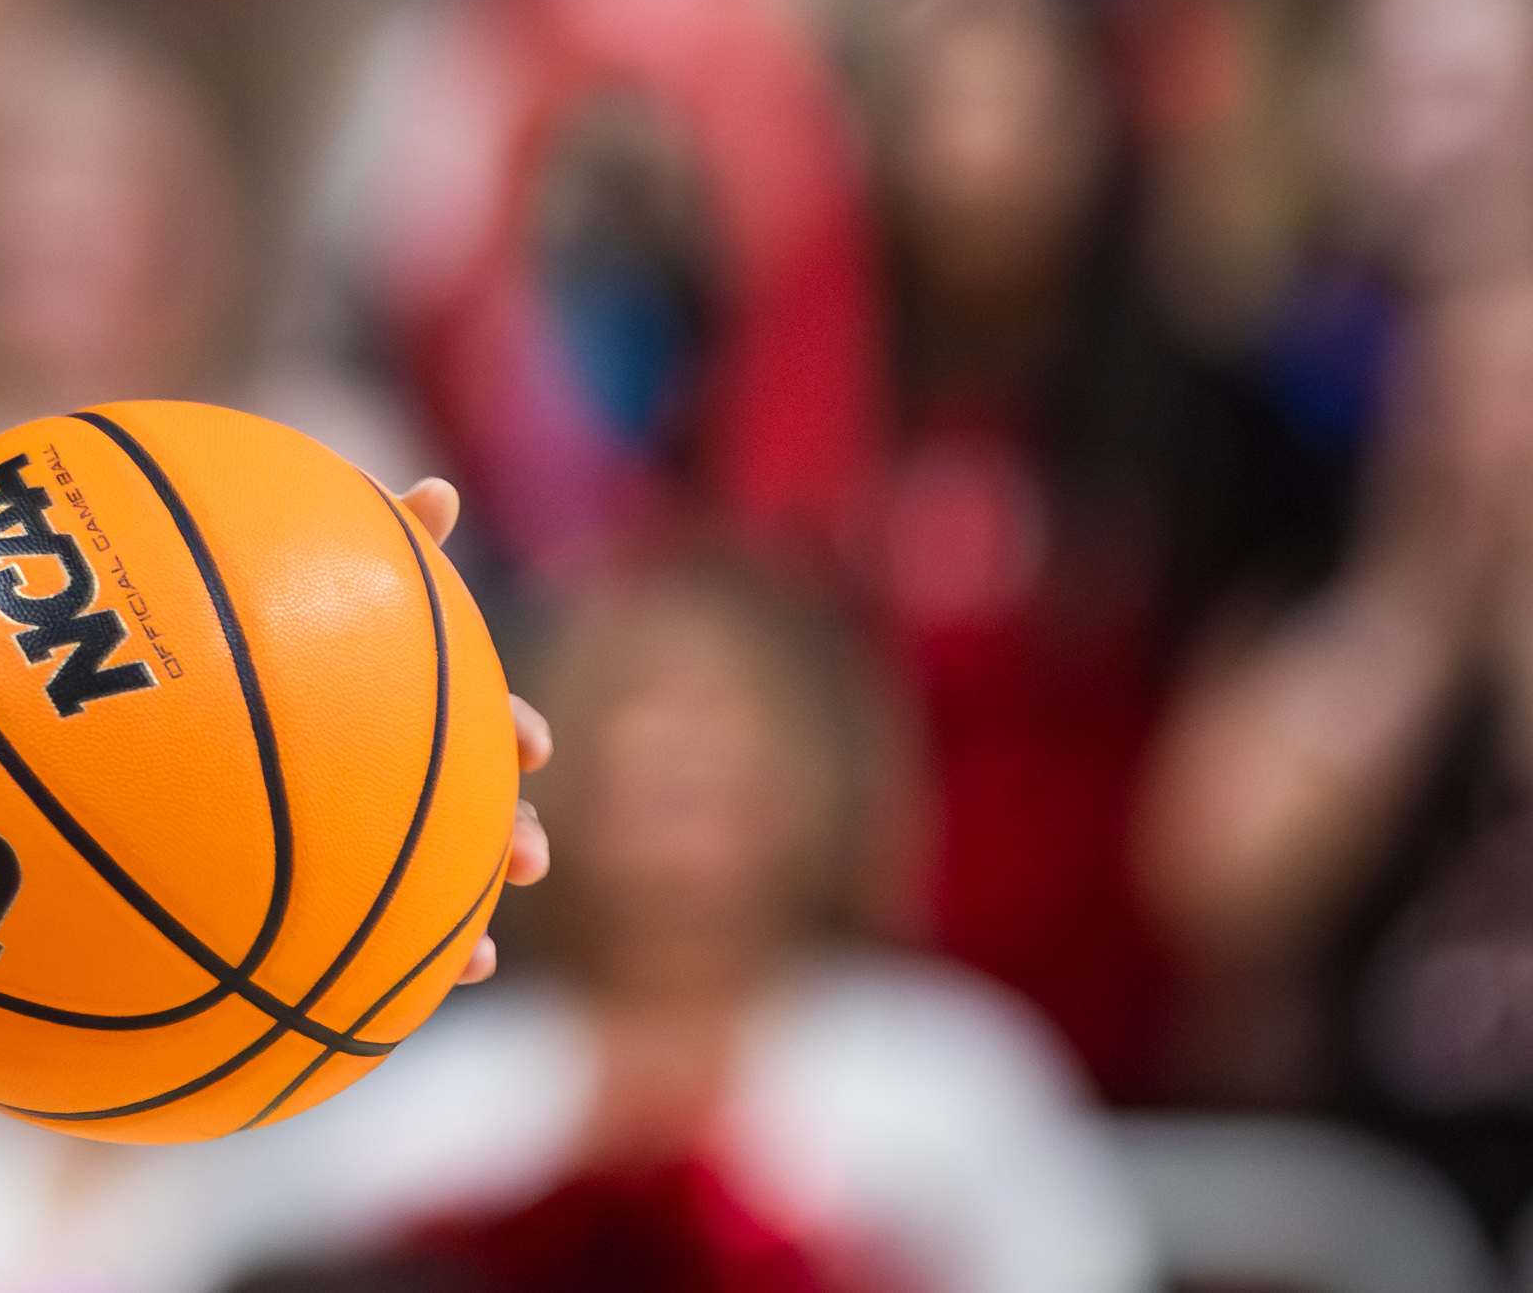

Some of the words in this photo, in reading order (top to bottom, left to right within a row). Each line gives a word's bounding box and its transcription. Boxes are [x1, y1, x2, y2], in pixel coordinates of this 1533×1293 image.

[41, 443, 74, 487] BALL
[65, 487, 112, 553] GAME
[111, 554, 185, 680] OFFICIAL
